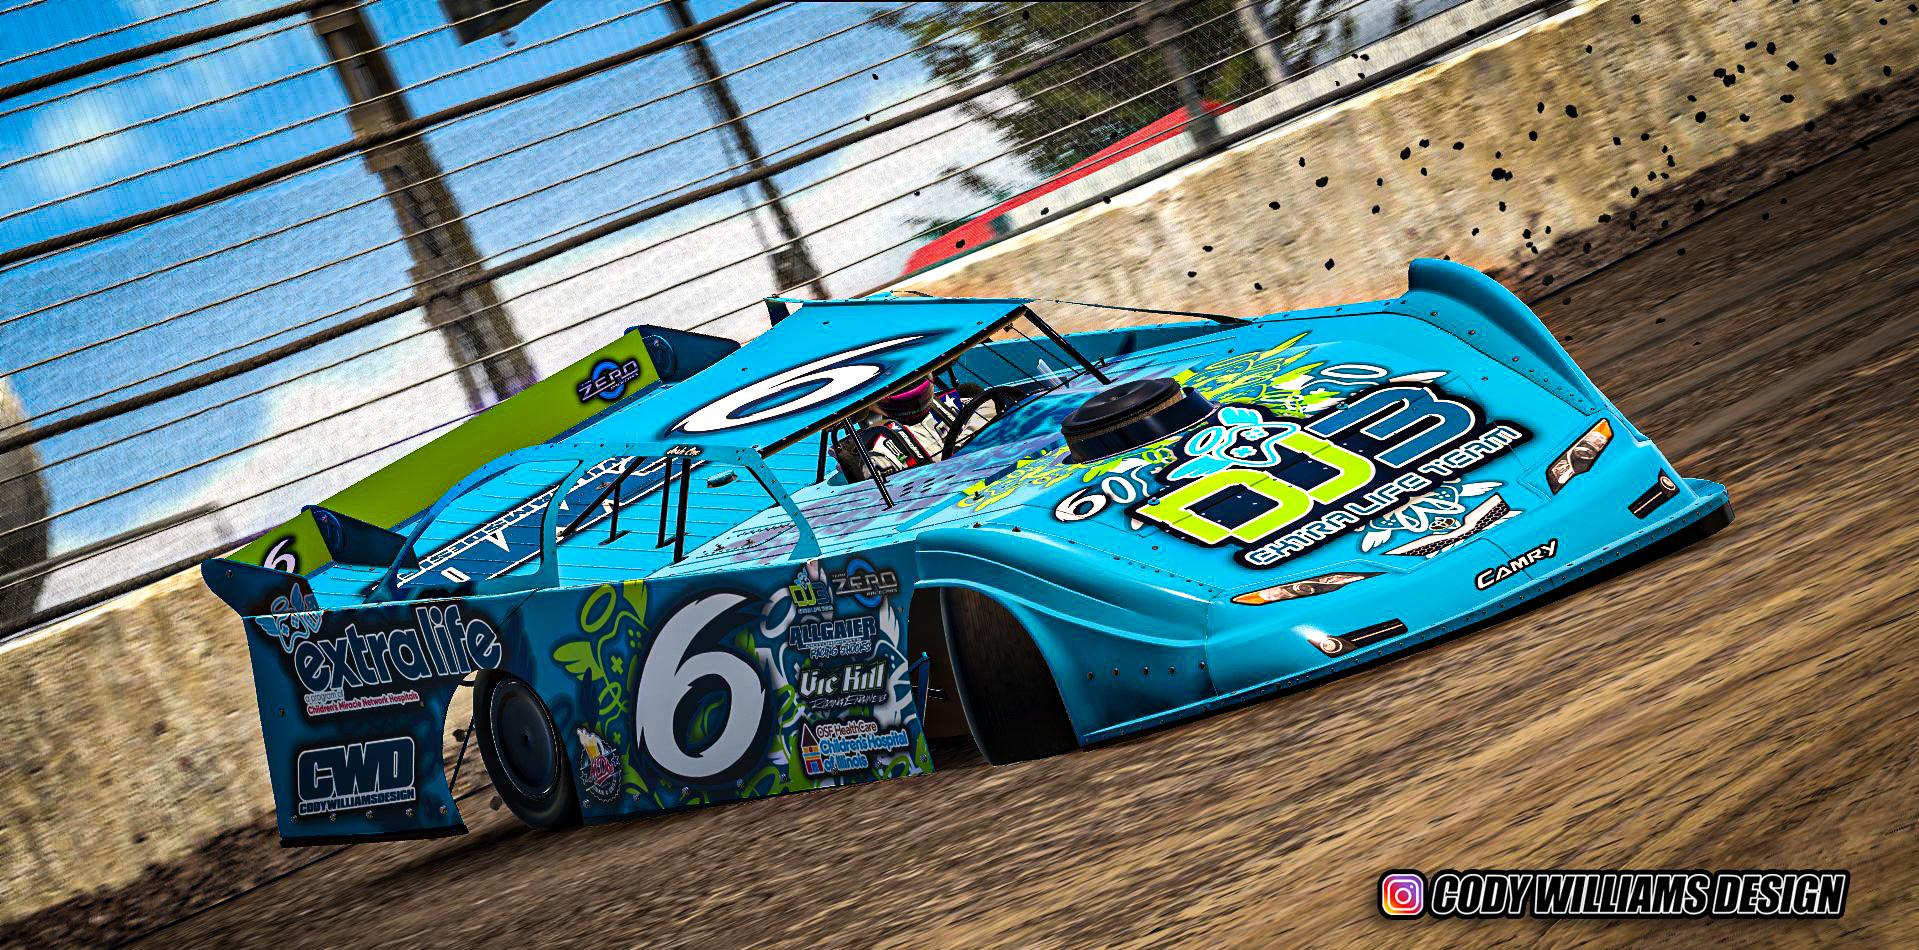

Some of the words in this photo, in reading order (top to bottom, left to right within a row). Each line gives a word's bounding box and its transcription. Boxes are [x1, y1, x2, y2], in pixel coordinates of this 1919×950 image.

[579, 360, 640, 401] ZERO
[674, 334, 930, 434] 6
[1349, 473, 1432, 516] LIFE
[1421, 425, 1523, 477] TEAM
[1055, 488, 1107, 522] 6
[263, 538, 296, 574] 6
[1476, 539, 1558, 589] CAMRY
[832, 571, 898, 595] ZERO
[789, 615, 877, 651] ALLGAIER
[339, 697, 362, 711] Miracle
[362, 694, 388, 709] Network
[388, 690, 420, 705] Hospitals
[635, 593, 766, 778] 6
[816, 724, 836, 739] OSF
[835, 720, 878, 737] HealthCare
[820, 735, 868, 755] Children's
[866, 729, 909, 752] Hospital
[298, 736, 415, 801] CWD
[824, 757, 836, 772] of
[835, 753, 869, 771] Illinois
